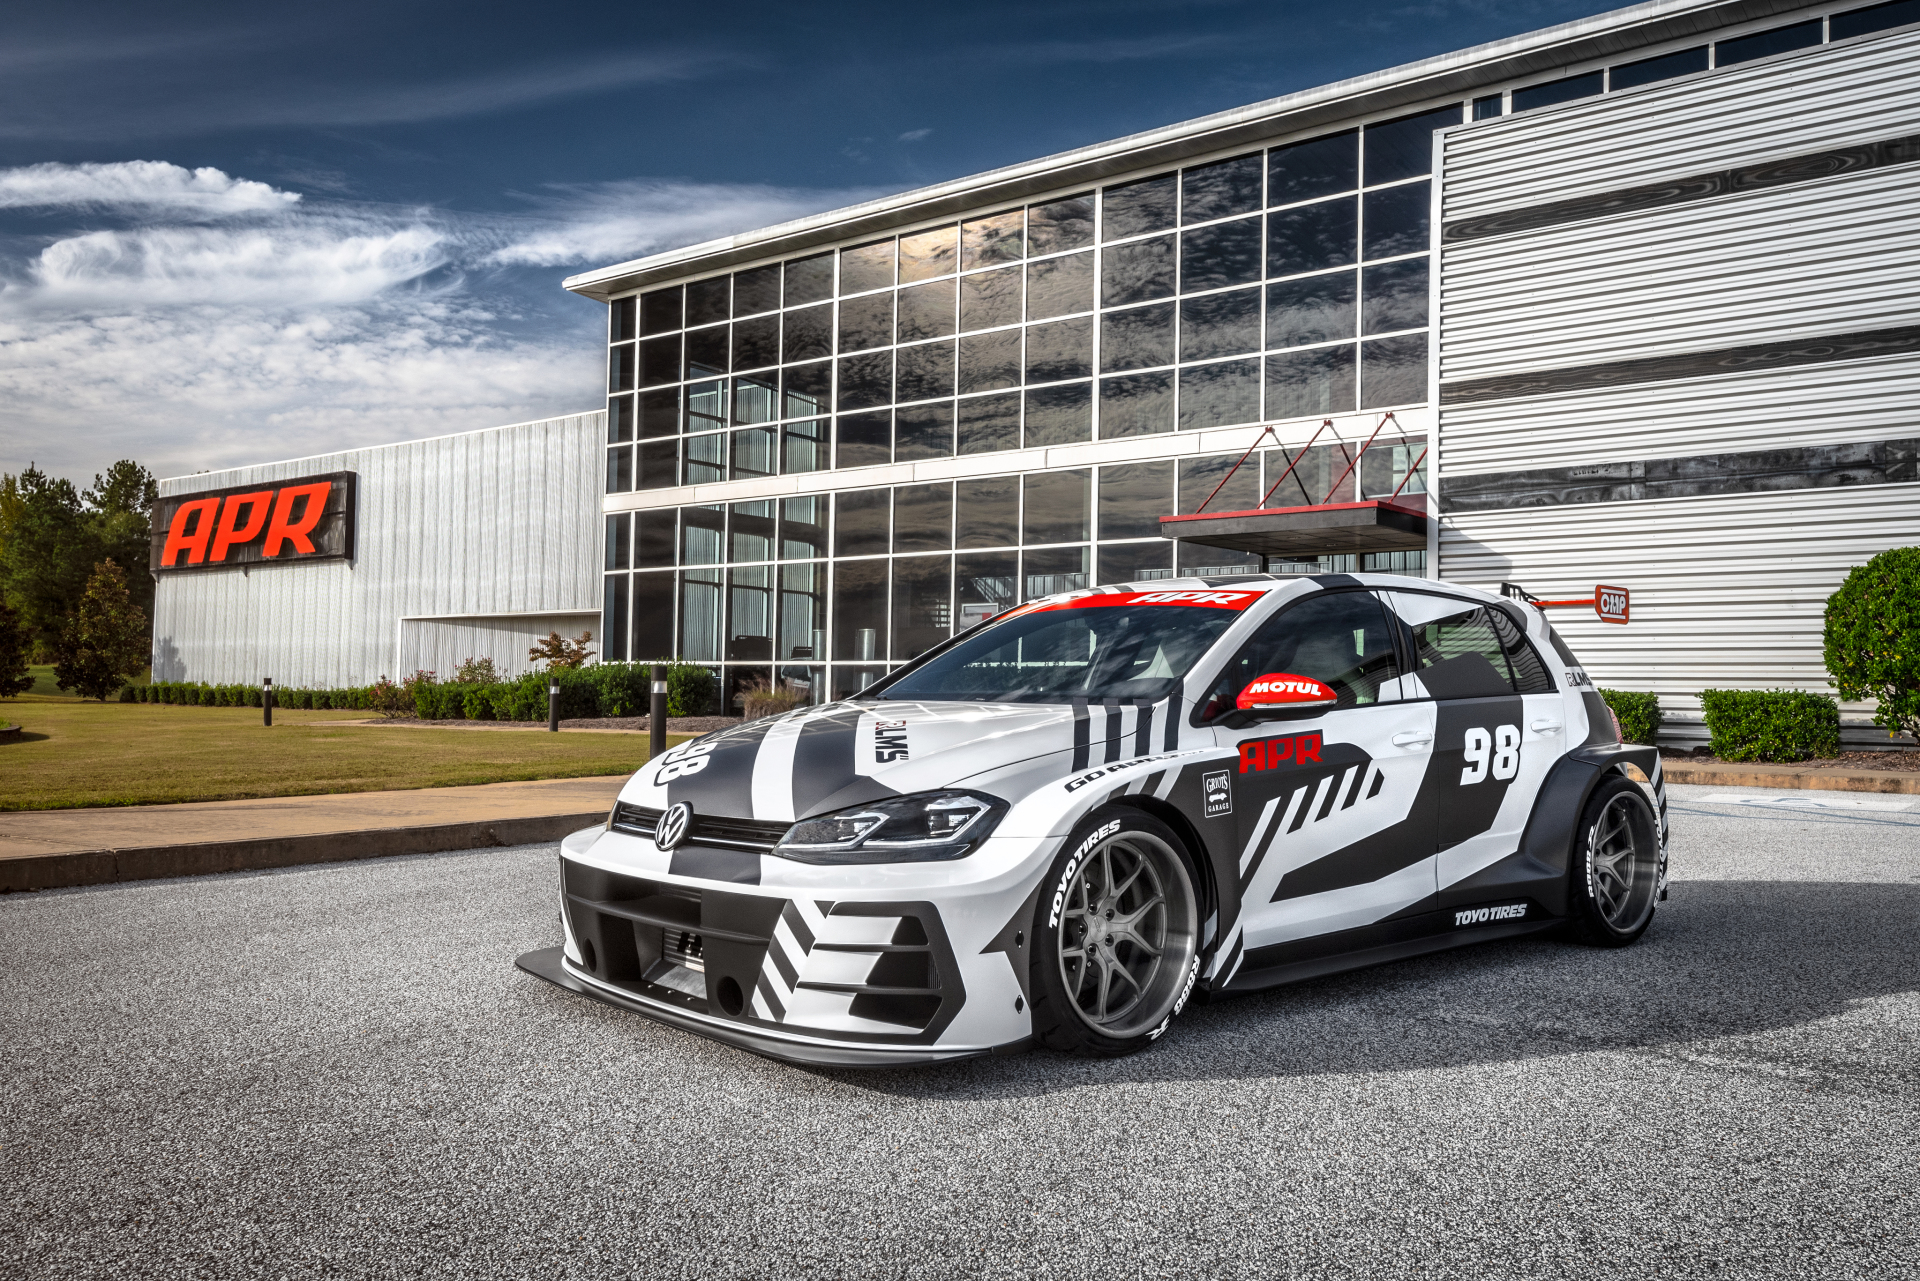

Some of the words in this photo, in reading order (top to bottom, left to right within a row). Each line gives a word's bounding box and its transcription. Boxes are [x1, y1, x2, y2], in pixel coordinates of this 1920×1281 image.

[160, 481, 332, 566] APR
[1126, 592, 1251, 604] APR
[1601, 594, 1626, 614] OMP
[1249, 682, 1321, 696] MOTUL
[655, 742, 718, 786] 98
[1239, 734, 1323, 774] APR
[1460, 724, 1520, 786] 98
[1208, 802, 1229, 812] GARAGE
